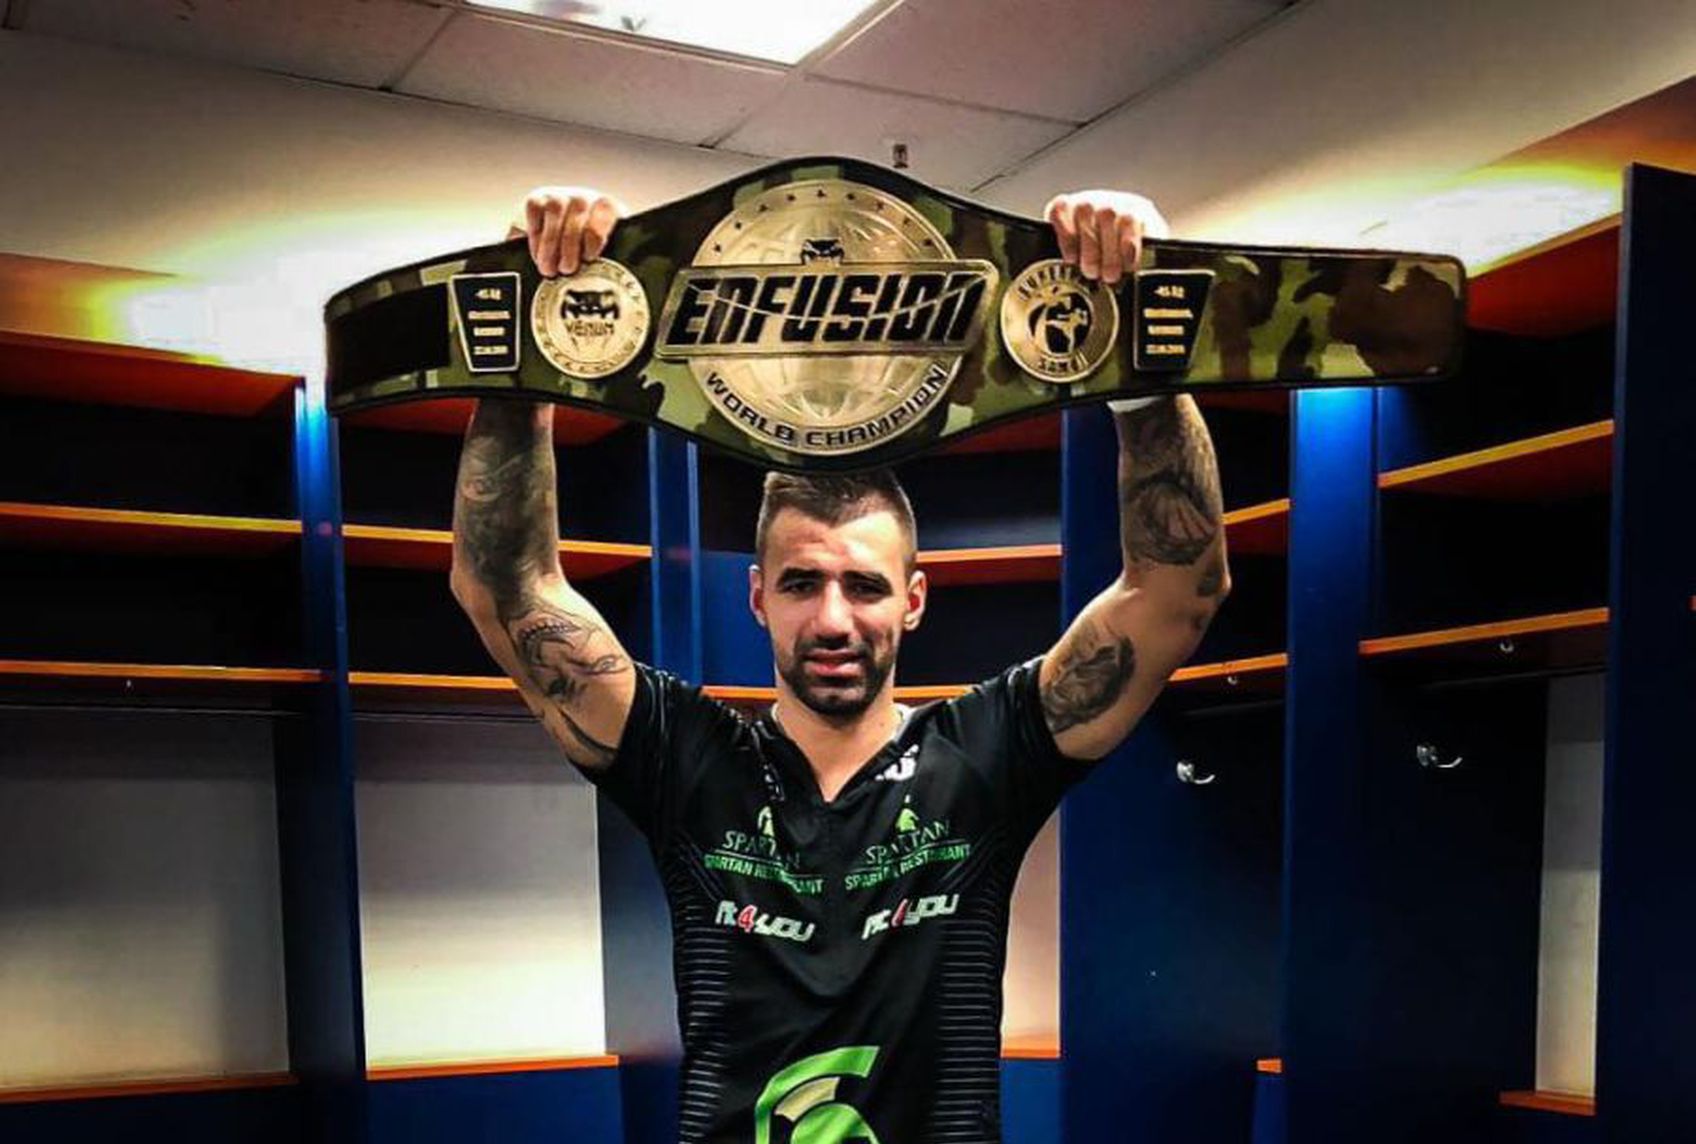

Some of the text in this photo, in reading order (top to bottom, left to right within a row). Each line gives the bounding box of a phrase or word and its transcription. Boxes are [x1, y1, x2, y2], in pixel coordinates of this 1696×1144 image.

[666, 272, 988, 345] ENFUSION
[705, 366, 949, 448] WORLD CHAMPION
